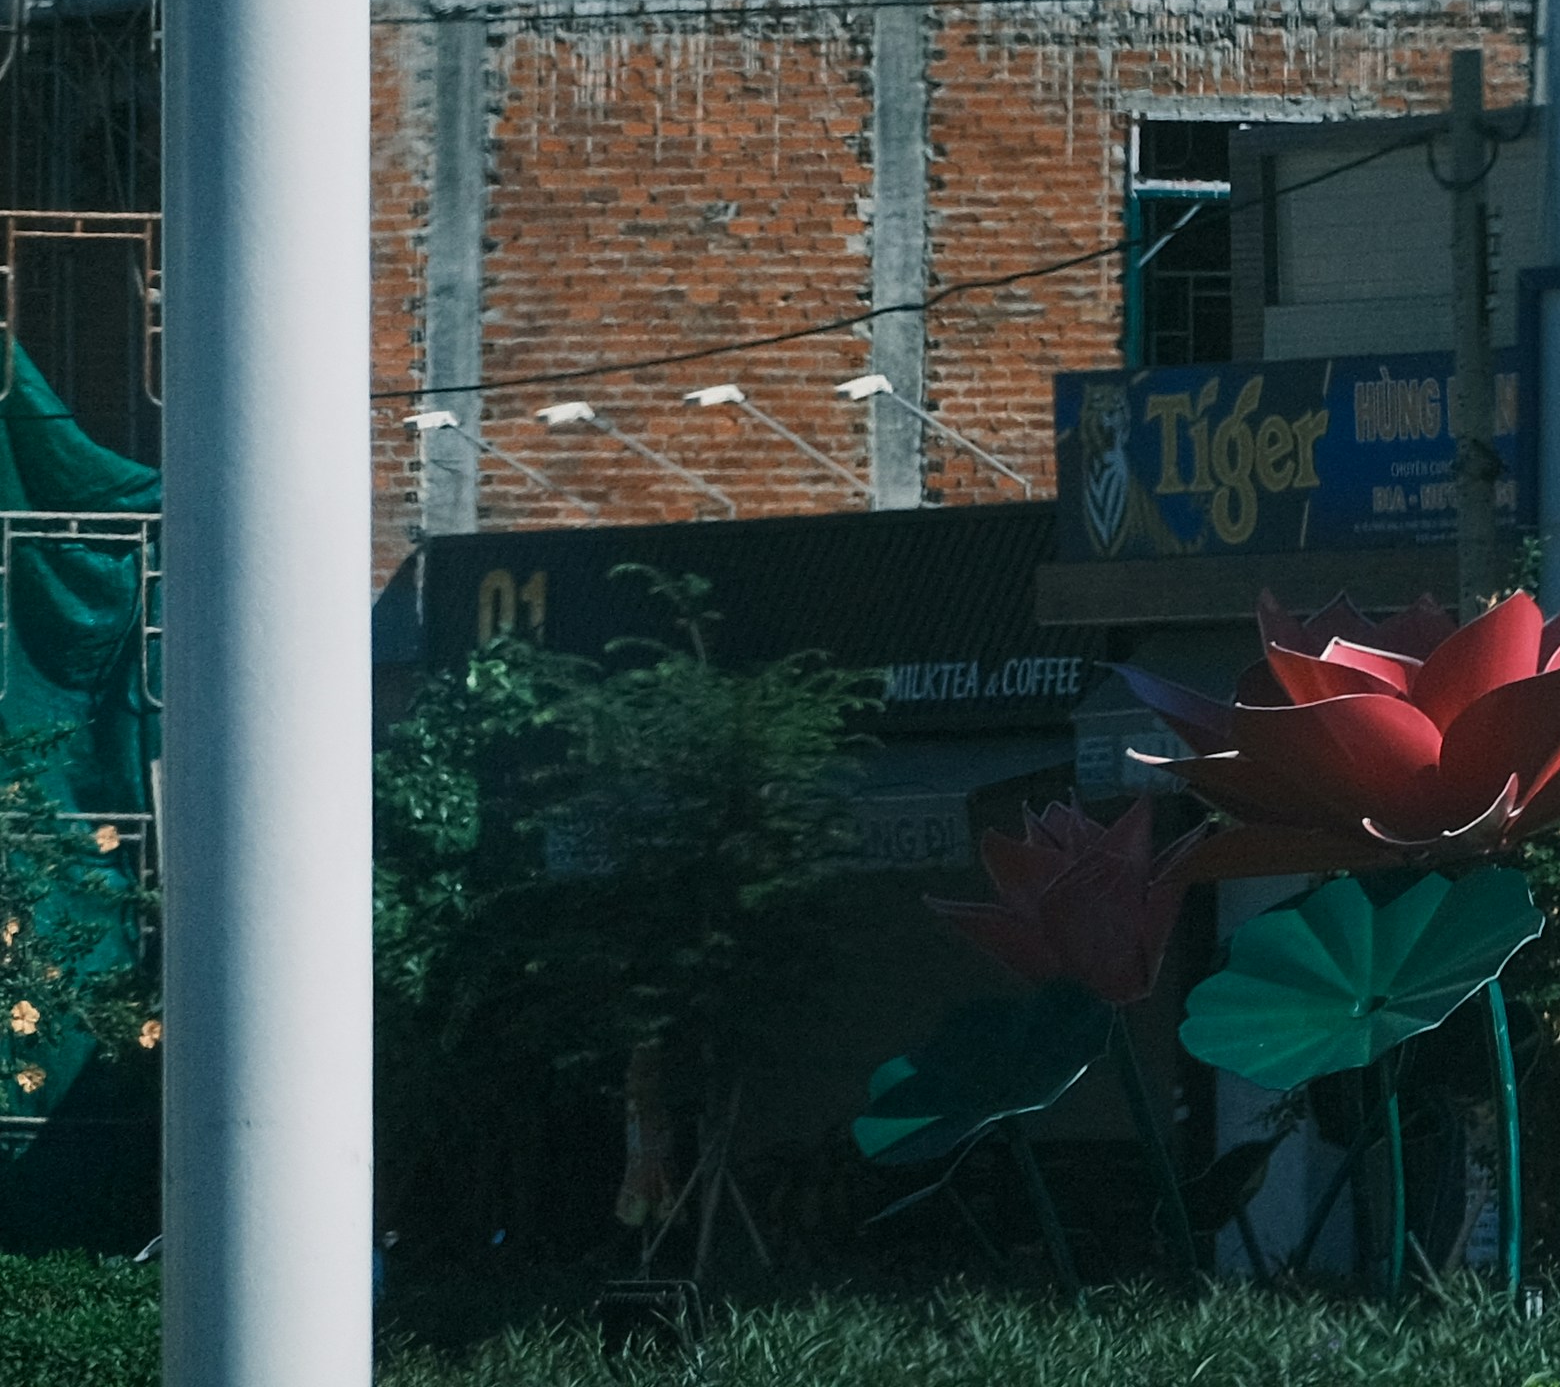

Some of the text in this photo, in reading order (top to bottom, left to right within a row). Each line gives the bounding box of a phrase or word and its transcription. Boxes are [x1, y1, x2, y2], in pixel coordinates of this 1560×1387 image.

[1354, 365, 1441, 443] HÙNG
[1145, 374, 1328, 544] Tiger
[884, 660, 980, 702] MILKTEA
[1002, 655, 1084, 696] COFFEE
